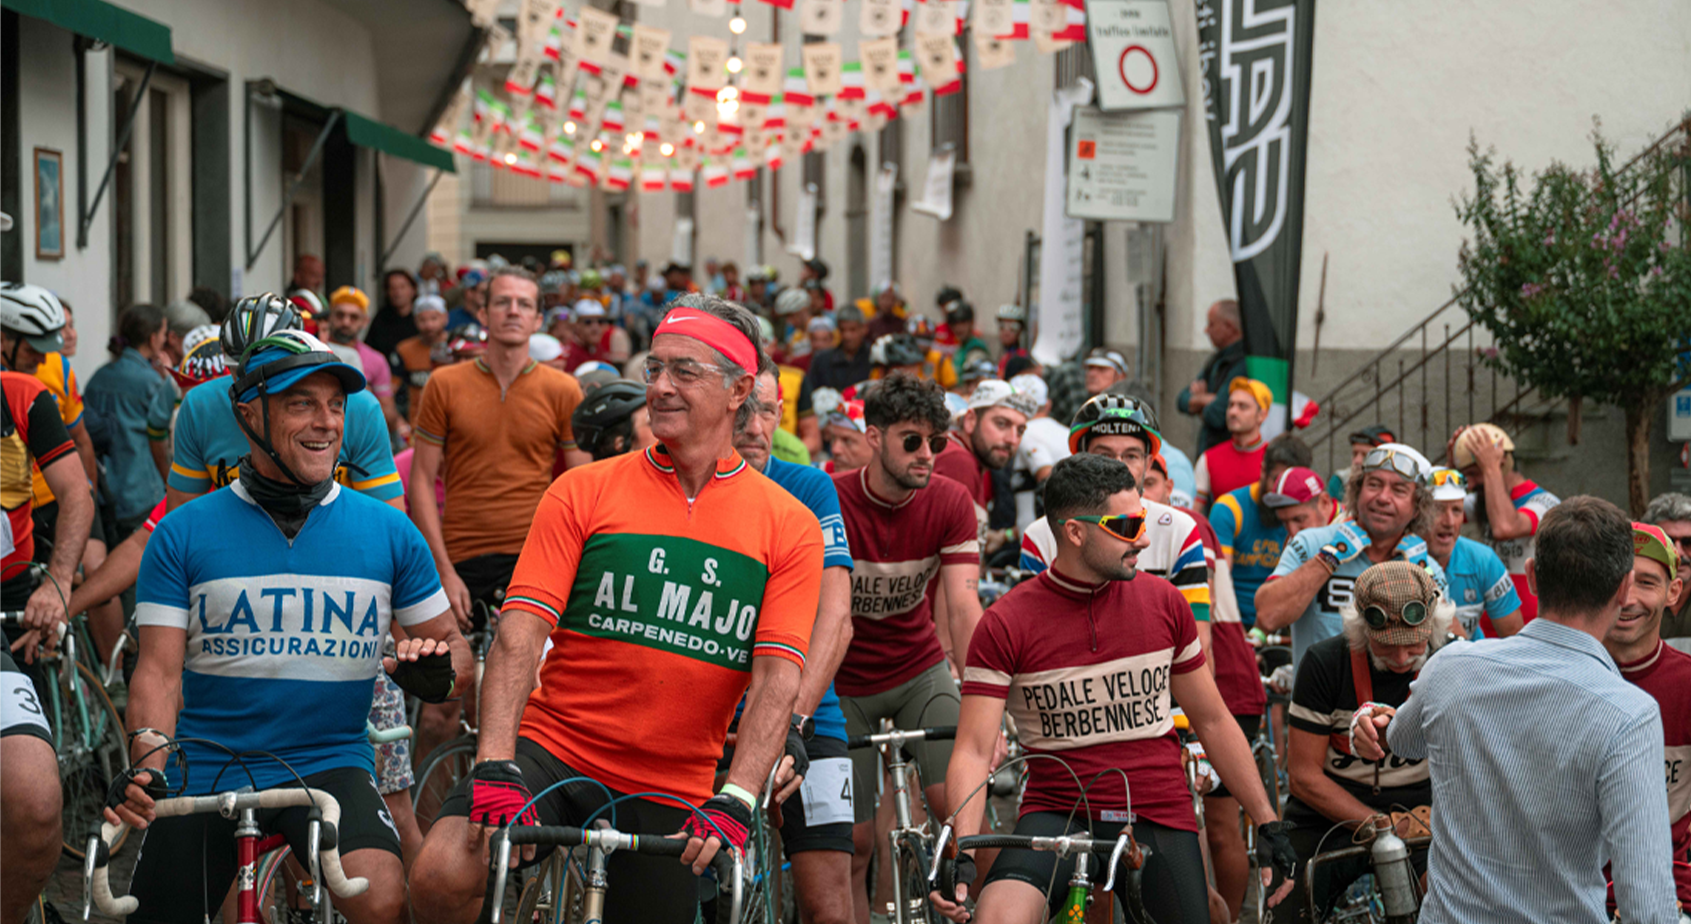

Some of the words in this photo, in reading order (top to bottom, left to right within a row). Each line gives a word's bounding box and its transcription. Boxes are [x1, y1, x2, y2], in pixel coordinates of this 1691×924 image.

[648, 547, 669, 575] G.
[702, 557, 722, 587] S.
[198, 587, 380, 637] LATINA
[593, 571, 638, 613] AL
[656, 580, 756, 641] MAJO
[202, 636, 378, 659] ASSICURAZIONI
[1021, 678, 1097, 711] PEDALE
[1102, 664, 1170, 702] VELOCE
[1040, 695, 1164, 738] BERBENNESE
